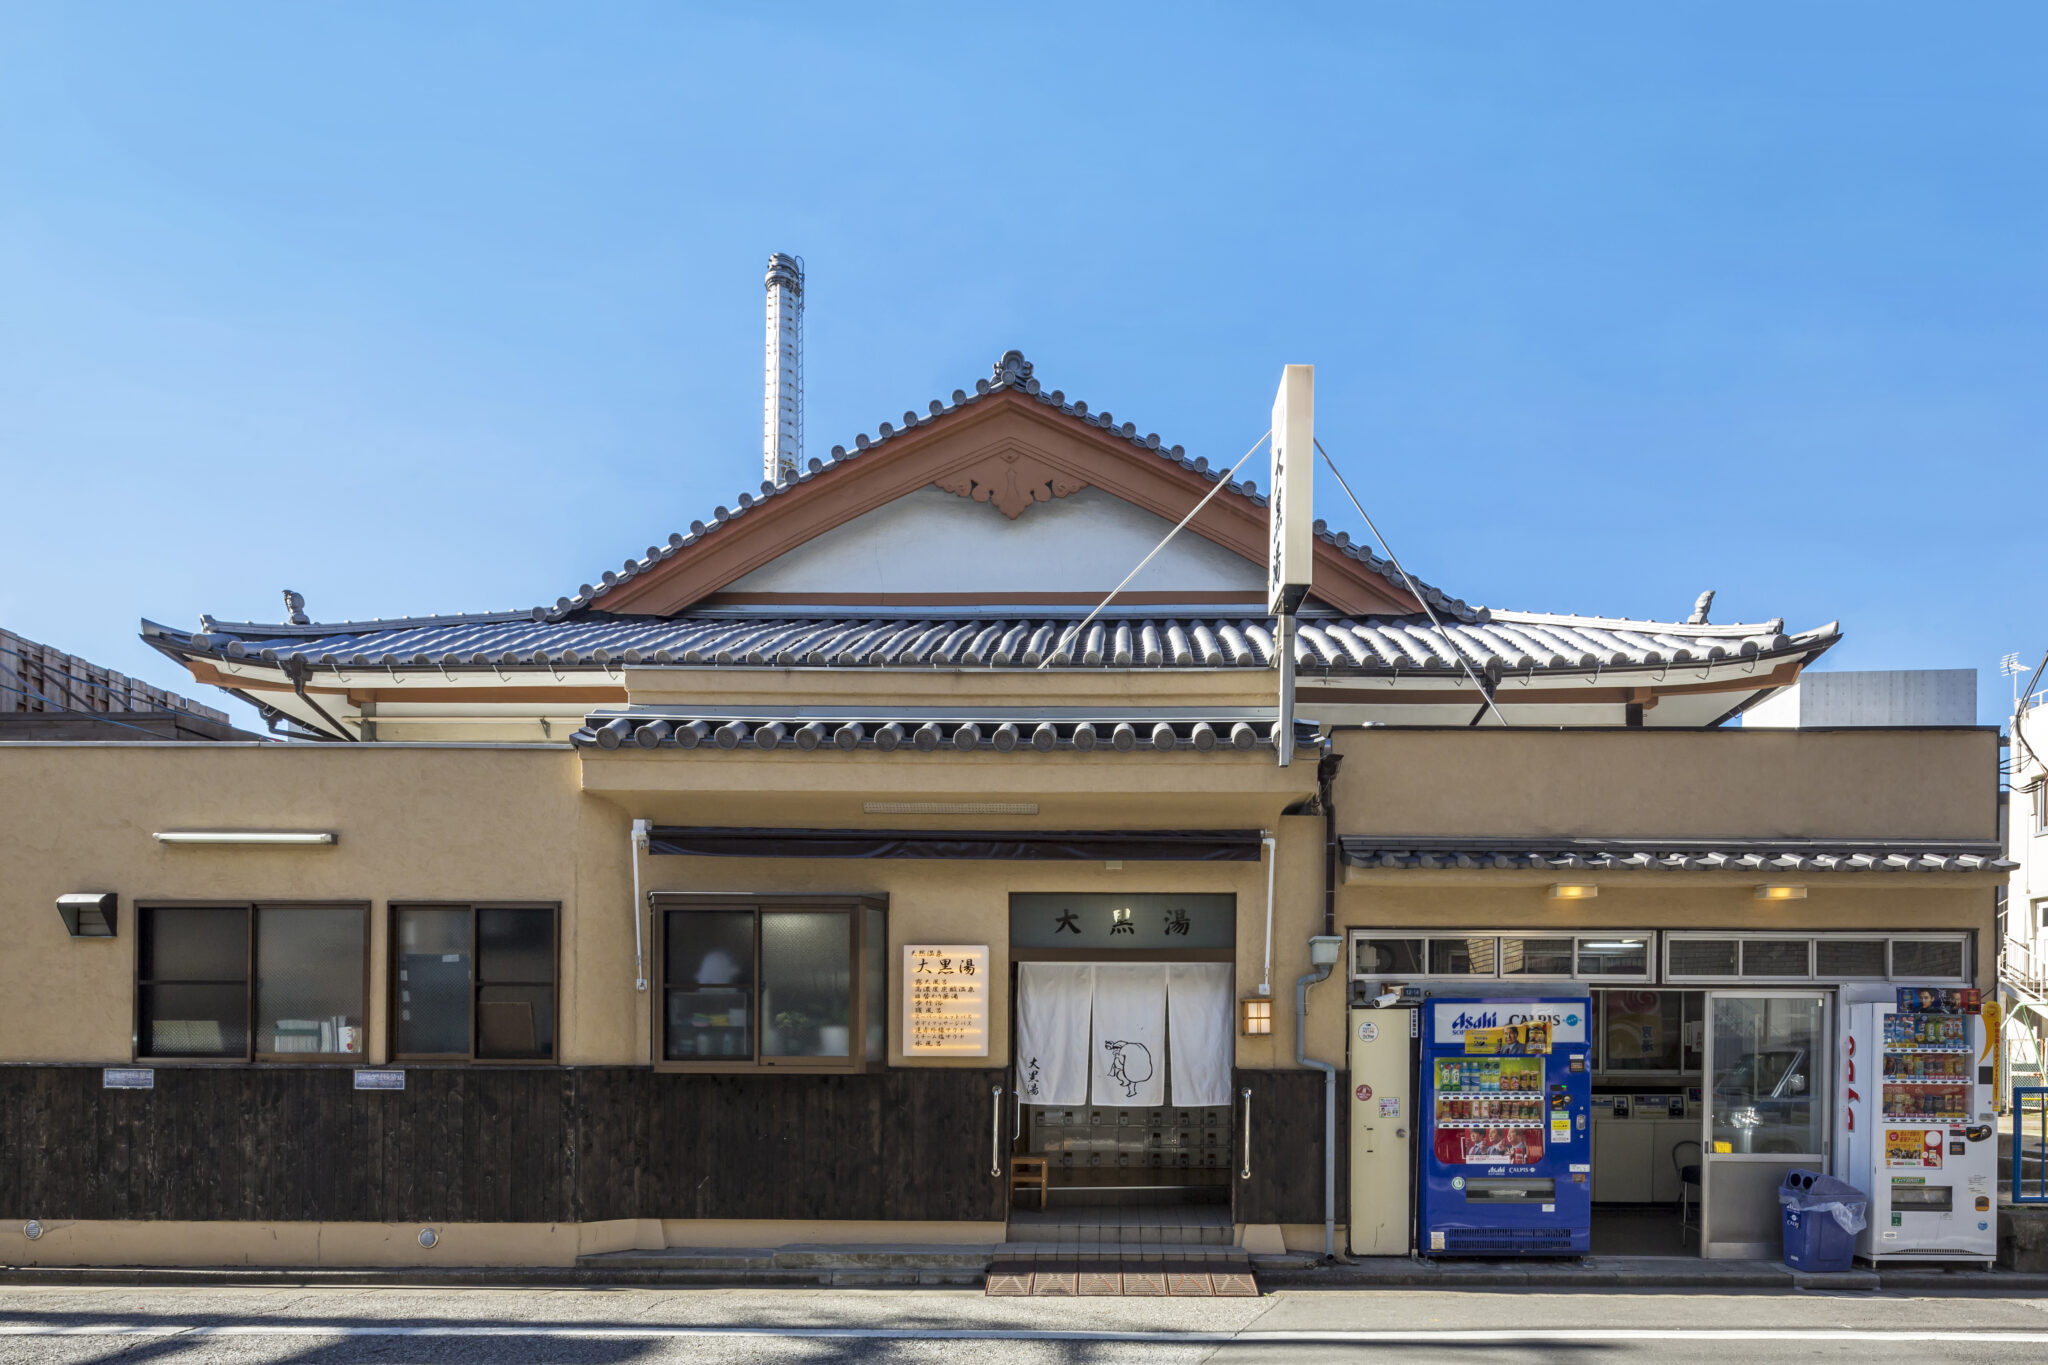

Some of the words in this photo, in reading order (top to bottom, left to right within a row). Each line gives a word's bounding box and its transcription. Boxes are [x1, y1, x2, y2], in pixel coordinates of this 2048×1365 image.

[1054, 908, 1191, 936] 大黒湯
[916, 958, 976, 976] 大黒湯
[1451, 1011, 1497, 1029] Asahi
[1026, 1056, 1040, 1096] 大黒湯
